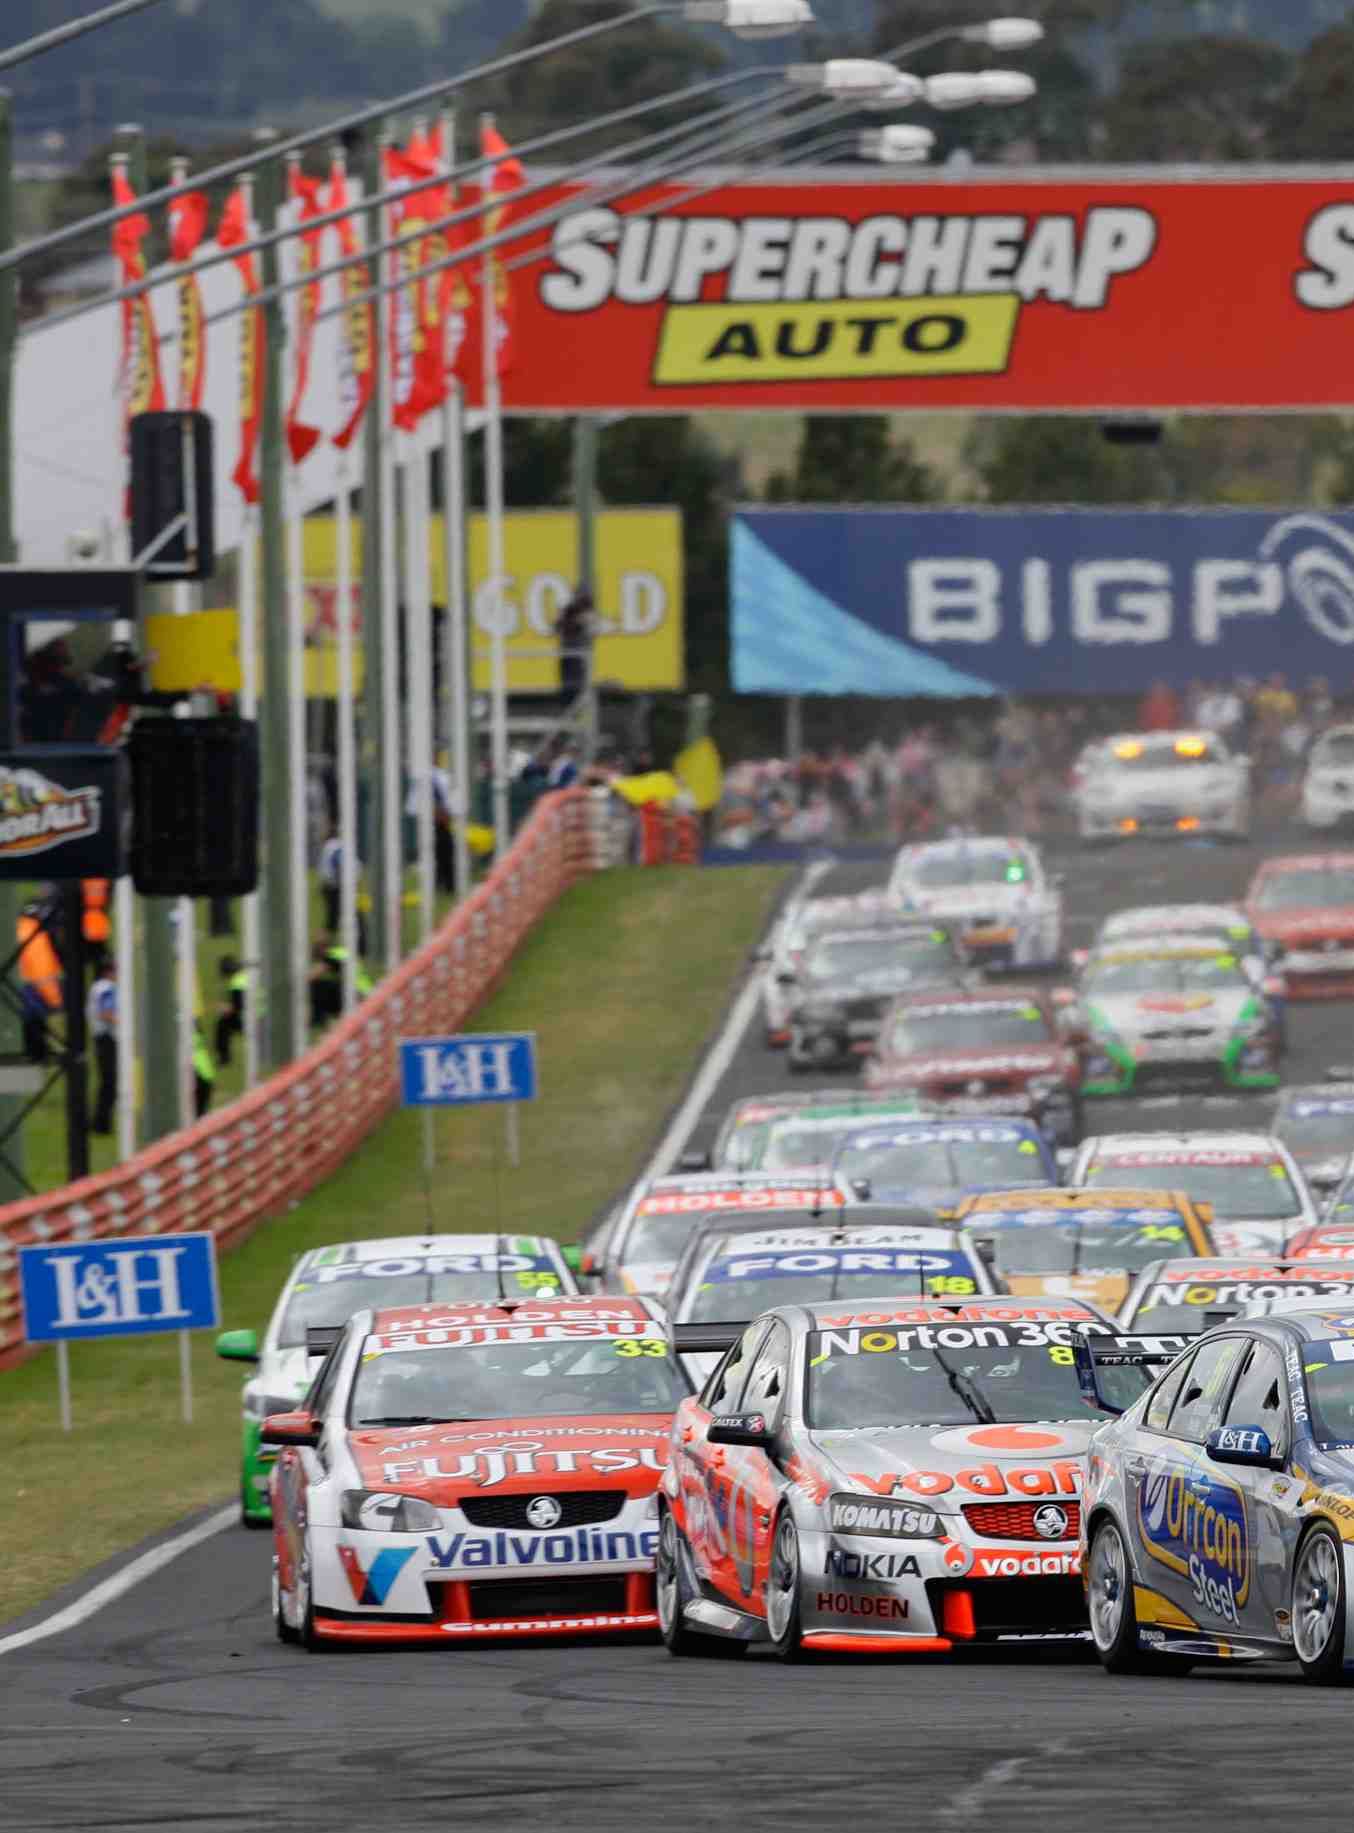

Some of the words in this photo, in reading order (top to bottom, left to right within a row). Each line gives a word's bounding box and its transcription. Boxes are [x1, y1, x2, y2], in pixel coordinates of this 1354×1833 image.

[541, 204, 1157, 312] SUPERCHEAP
[704, 314, 968, 361] AUTO
[854, 1128, 1022, 1148] FORD
[644, 1190, 837, 1216] HOLDEN
[753, 1236, 818, 1247] JIM
[312, 1253, 535, 1284] FORD
[728, 1253, 953, 1277] FORD
[513, 1271, 561, 1288] 55
[927, 1276, 977, 1294] 18
[1148, 1282, 1315, 1306] Norton
[387, 1310, 634, 1332] HOLDEN
[819, 1306, 1095, 1326] vodafone
[379, 1321, 649, 1349] FUJITSU
[819, 1324, 1008, 1356] Norton
[611, 1338, 668, 1358] 33
[1047, 1346, 1074, 1366] 8
[379, 1439, 428, 1455] AIR
[833, 1503, 936, 1534] KOMATSU
[1168, 1471, 1243, 1580] Orrcon
[427, 1528, 660, 1568] Valvoline
[824, 1551, 922, 1579] NOKIA
[1188, 1553, 1241, 1629] Steel
[817, 1592, 909, 1619] HOLDEN
[440, 1613, 658, 1632] Cummins
